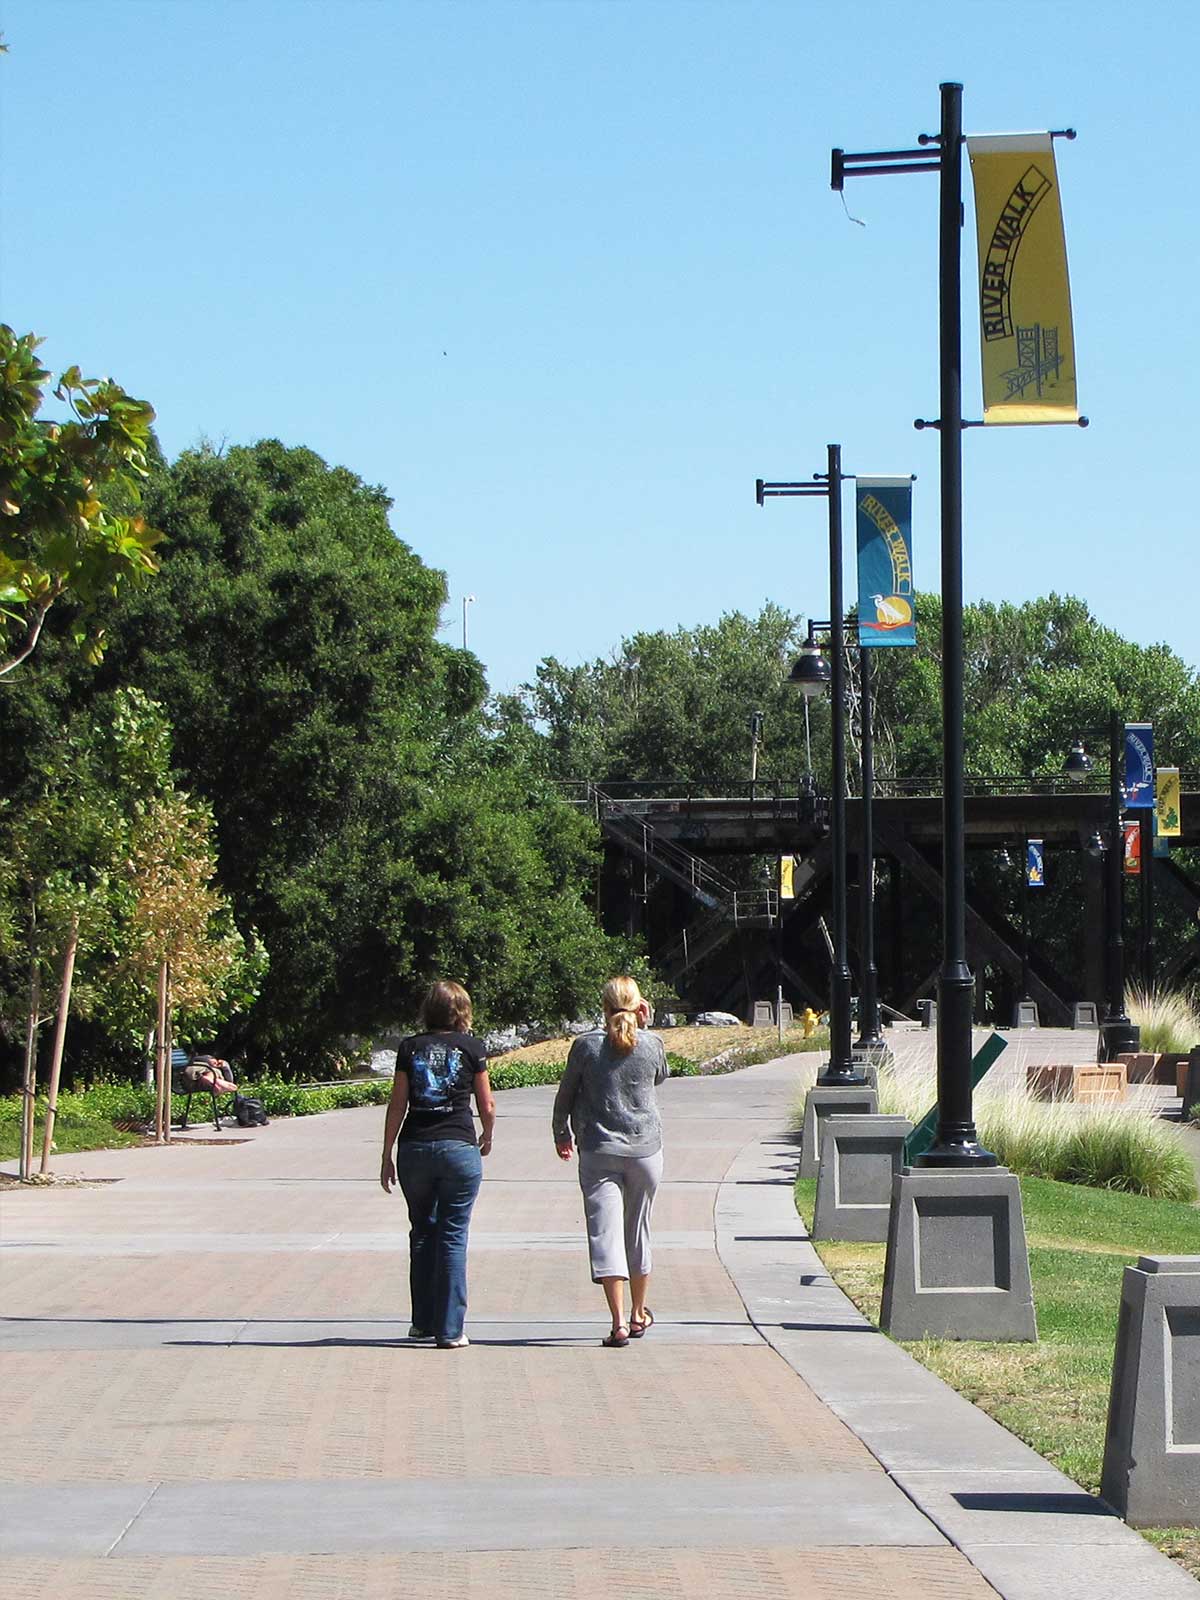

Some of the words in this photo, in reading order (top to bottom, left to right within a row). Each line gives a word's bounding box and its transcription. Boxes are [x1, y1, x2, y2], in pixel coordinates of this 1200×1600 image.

[991, 182, 1036, 250] WALK
[985, 261, 1006, 338] RIVER
[864, 495, 898, 533] RIVER
[891, 539, 911, 583] WALK
